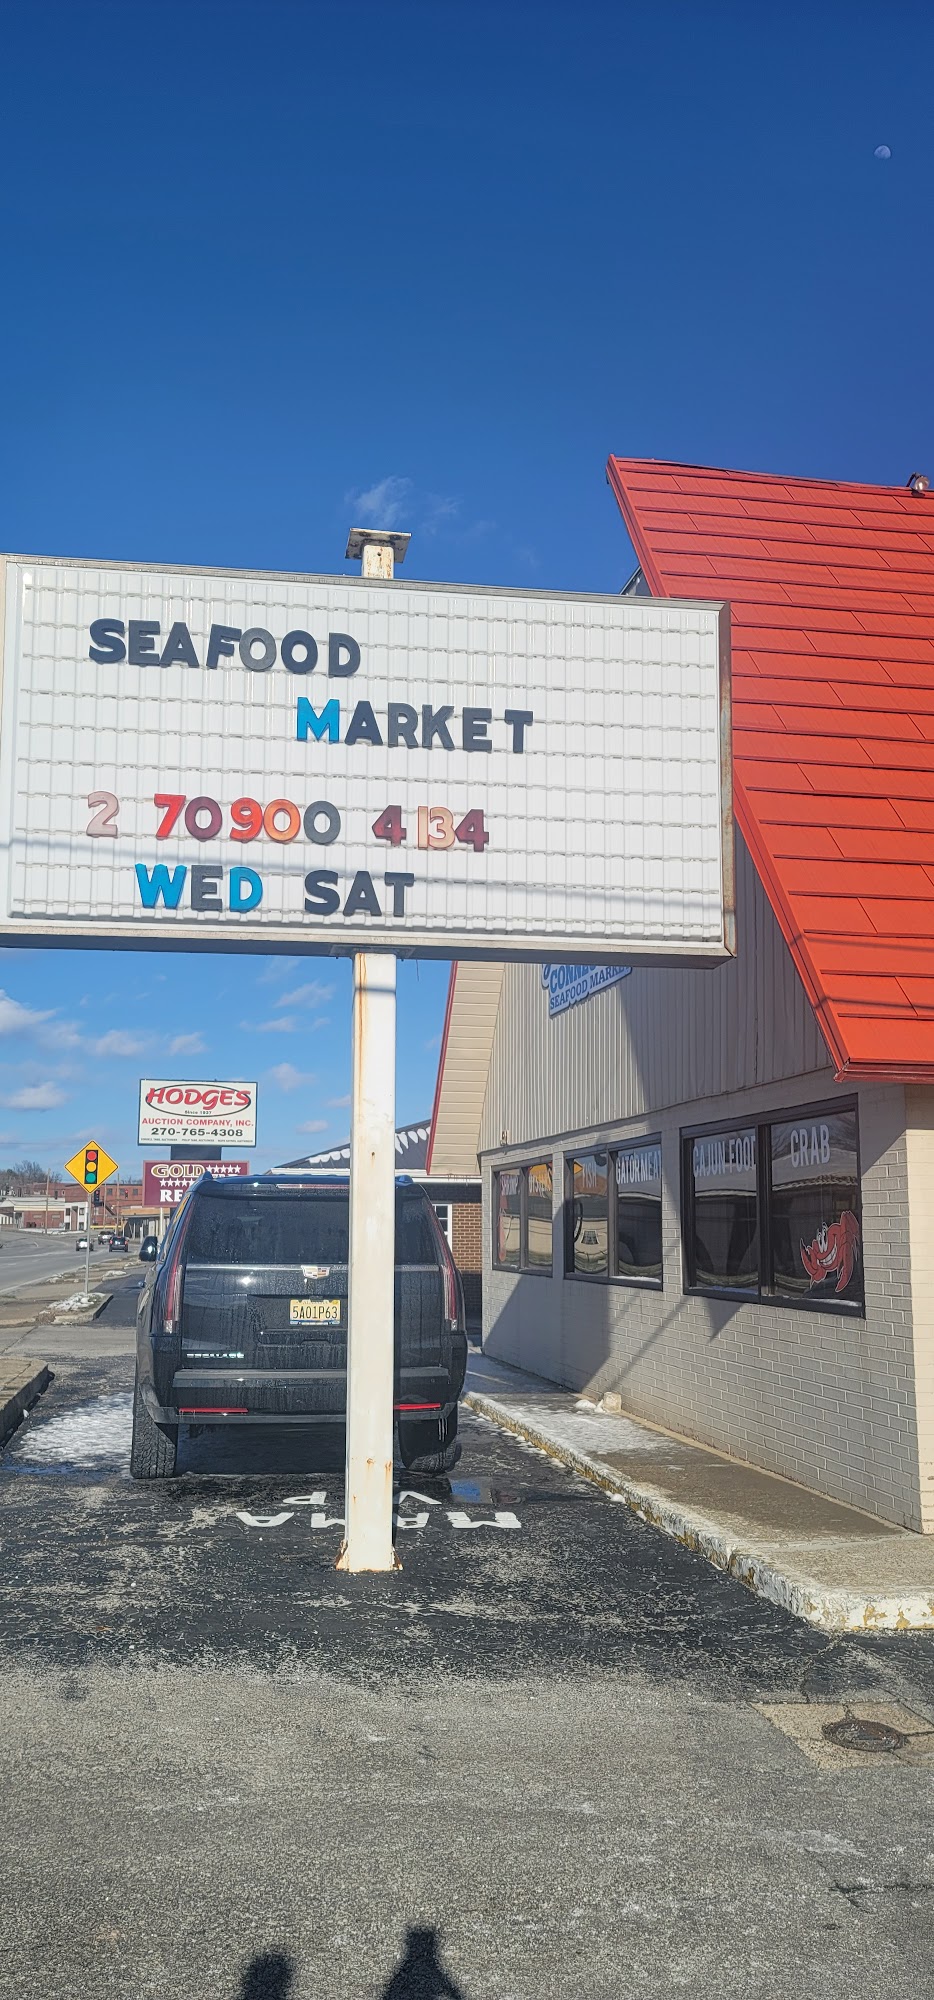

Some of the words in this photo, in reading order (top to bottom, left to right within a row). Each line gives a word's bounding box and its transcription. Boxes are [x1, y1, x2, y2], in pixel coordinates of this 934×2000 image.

[88, 618, 361, 678] SEAFOOD
[296, 696, 533, 754] MARKET
[87, 790, 120, 838] 2
[135, 862, 264, 912] WED
[303, 869, 415, 917] SAT
[550, 965, 596, 993] CONN
[550, 980, 588, 1010] SEAFOOD
[146, 1087, 251, 1110] HODGES
[151, 1127, 243, 1137] 270-765-4308
[186, 1119, 233, 1127] COMPANY,
[692, 1141, 726, 1178] CAJUN
[790, 1124, 830, 1168] CRAB
[151, 1164, 205, 1178] GOLD
